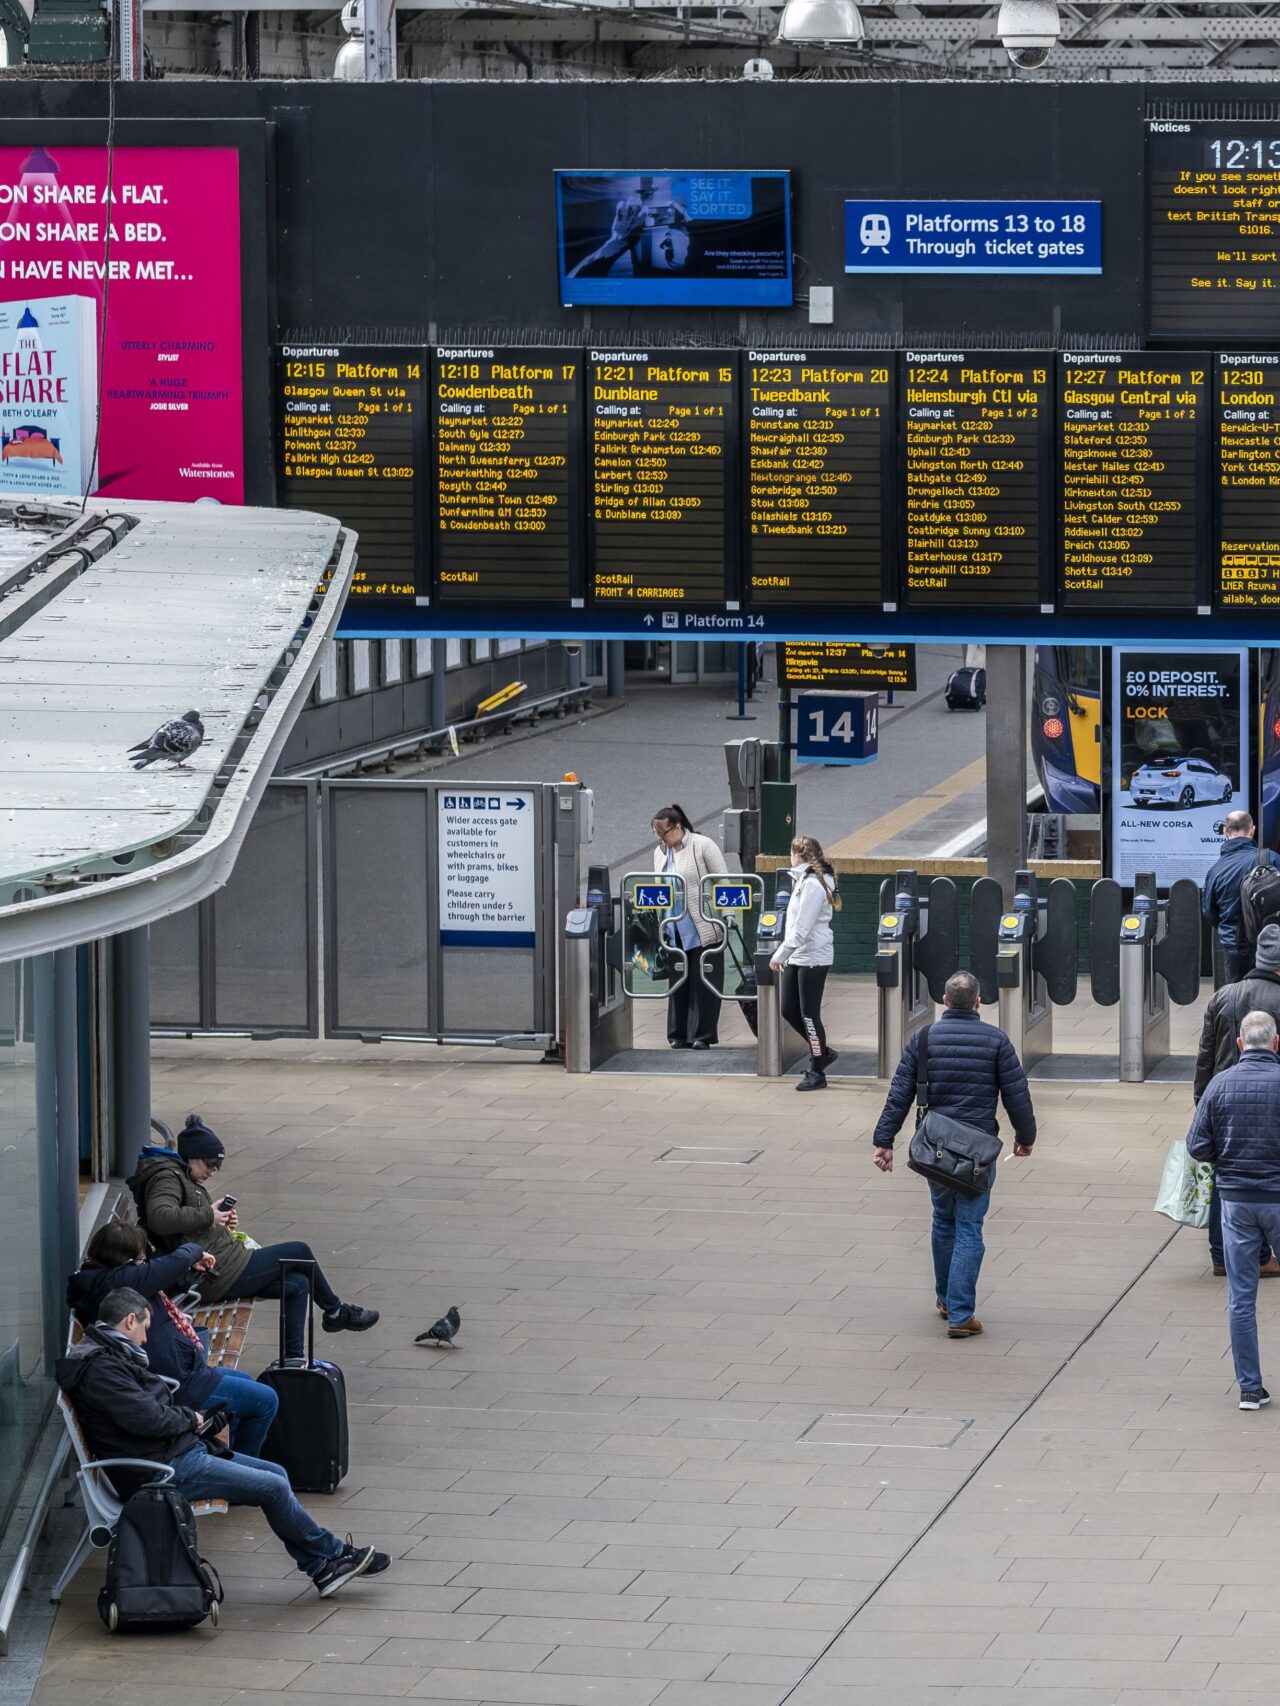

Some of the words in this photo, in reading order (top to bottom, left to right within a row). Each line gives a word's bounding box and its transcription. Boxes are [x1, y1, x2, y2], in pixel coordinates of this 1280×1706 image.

[1150, 122, 1191, 133] Notices
[1181, 172, 1191, 180] If
[1196, 174, 1216, 182] you
[33, 185, 96, 204] SHARE
[101, 185, 117, 204] A
[122, 184, 168, 205] FLAT.
[1174, 185, 1217, 193] doesn't
[1223, 185, 1246, 194] look
[1233, 199, 1263, 207] staff
[1168, 212, 1191, 220] text
[1197, 212, 1240, 220] British
[907, 214, 998, 232] Platforms
[1005, 215, 1028, 232] 13
[1034, 217, 1055, 232] to
[1062, 215, 1085, 232] 18
[36, 222, 99, 241] SHARE
[104, 223, 119, 241] A
[125, 222, 167, 242] BED.
[1240, 225, 1274, 234] 61016.
[906, 239, 975, 257] Through
[985, 239, 1033, 254] ticket
[1038, 241, 1084, 258] gates
[1218, 252, 1246, 260] We'll
[1252, 252, 1277, 261] sort
[11, 260, 63, 280] HAVE
[68, 260, 131, 280] NEVER
[135, 260, 193, 280] MET...
[1191, 278, 1211, 287] See
[1218, 279, 1230, 287] it.
[1236, 279, 1256, 289] Say
[1263, 279, 1275, 287] it.
[19, 339, 37, 350] THE
[283, 347, 340, 358] Departures
[3, 351, 56, 376] FLAT
[441, 365, 479, 378] 12:18
[492, 365, 552, 379] Platform
[562, 366, 575, 379] 17
[753, 369, 791, 382] 12:23
[802, 369, 863, 382] Platform
[871, 370, 888, 382] 20
[1224, 371, 1263, 384] 12:30
[439, 384, 532, 398] Cowdenbeath
[594, 386, 658, 401] Dunblane
[751, 388, 830, 402] Tweedbank
[1222, 391, 1274, 404] London
[3, 409, 21, 417] BETH
[24, 409, 57, 417] O'LEARY
[440, 455, 465, 464] North
[470, 455, 530, 467] Queensferry
[534, 456, 565, 465] (12:37)
[179, 467, 235, 479] Waterstones
[1222, 542, 1279, 551] Reservation
[1222, 581, 1243, 590] LNER
[1248, 582, 1276, 590] Azuma
[596, 588, 623, 596] FRONT
[628, 588, 632, 597] 4
[637, 588, 684, 597] CARRIAGES
[686, 615, 743, 627] Platform
[748, 616, 764, 627] 14
[825, 648, 847, 657] 12:37
[1127, 672, 1145, 682] £0
[1150, 672, 1218, 683] DEPOSIT.
[1127, 685, 1149, 696] 0%
[1153, 684, 1231, 697] INTEREST.
[1126, 706, 1168, 719] LOCK
[809, 710, 854, 743] 14
[865, 707, 877, 742] 14
[446, 816, 470, 825] Wider
[500, 818, 517, 826] gate
[447, 828, 483, 836] available
[485, 828, 497, 836] for
[447, 840, 488, 848] customers
[447, 851, 494, 859] wheelchairs
[498, 863, 518, 871] bikes
[457, 874, 489, 884] luggage
[446, 889, 473, 898] Please
[475, 892, 495, 900] carry
[508, 902, 513, 910] 5
[448, 912, 479, 922] through
[482, 913, 495, 921] the
[498, 913, 525, 921] barrier
